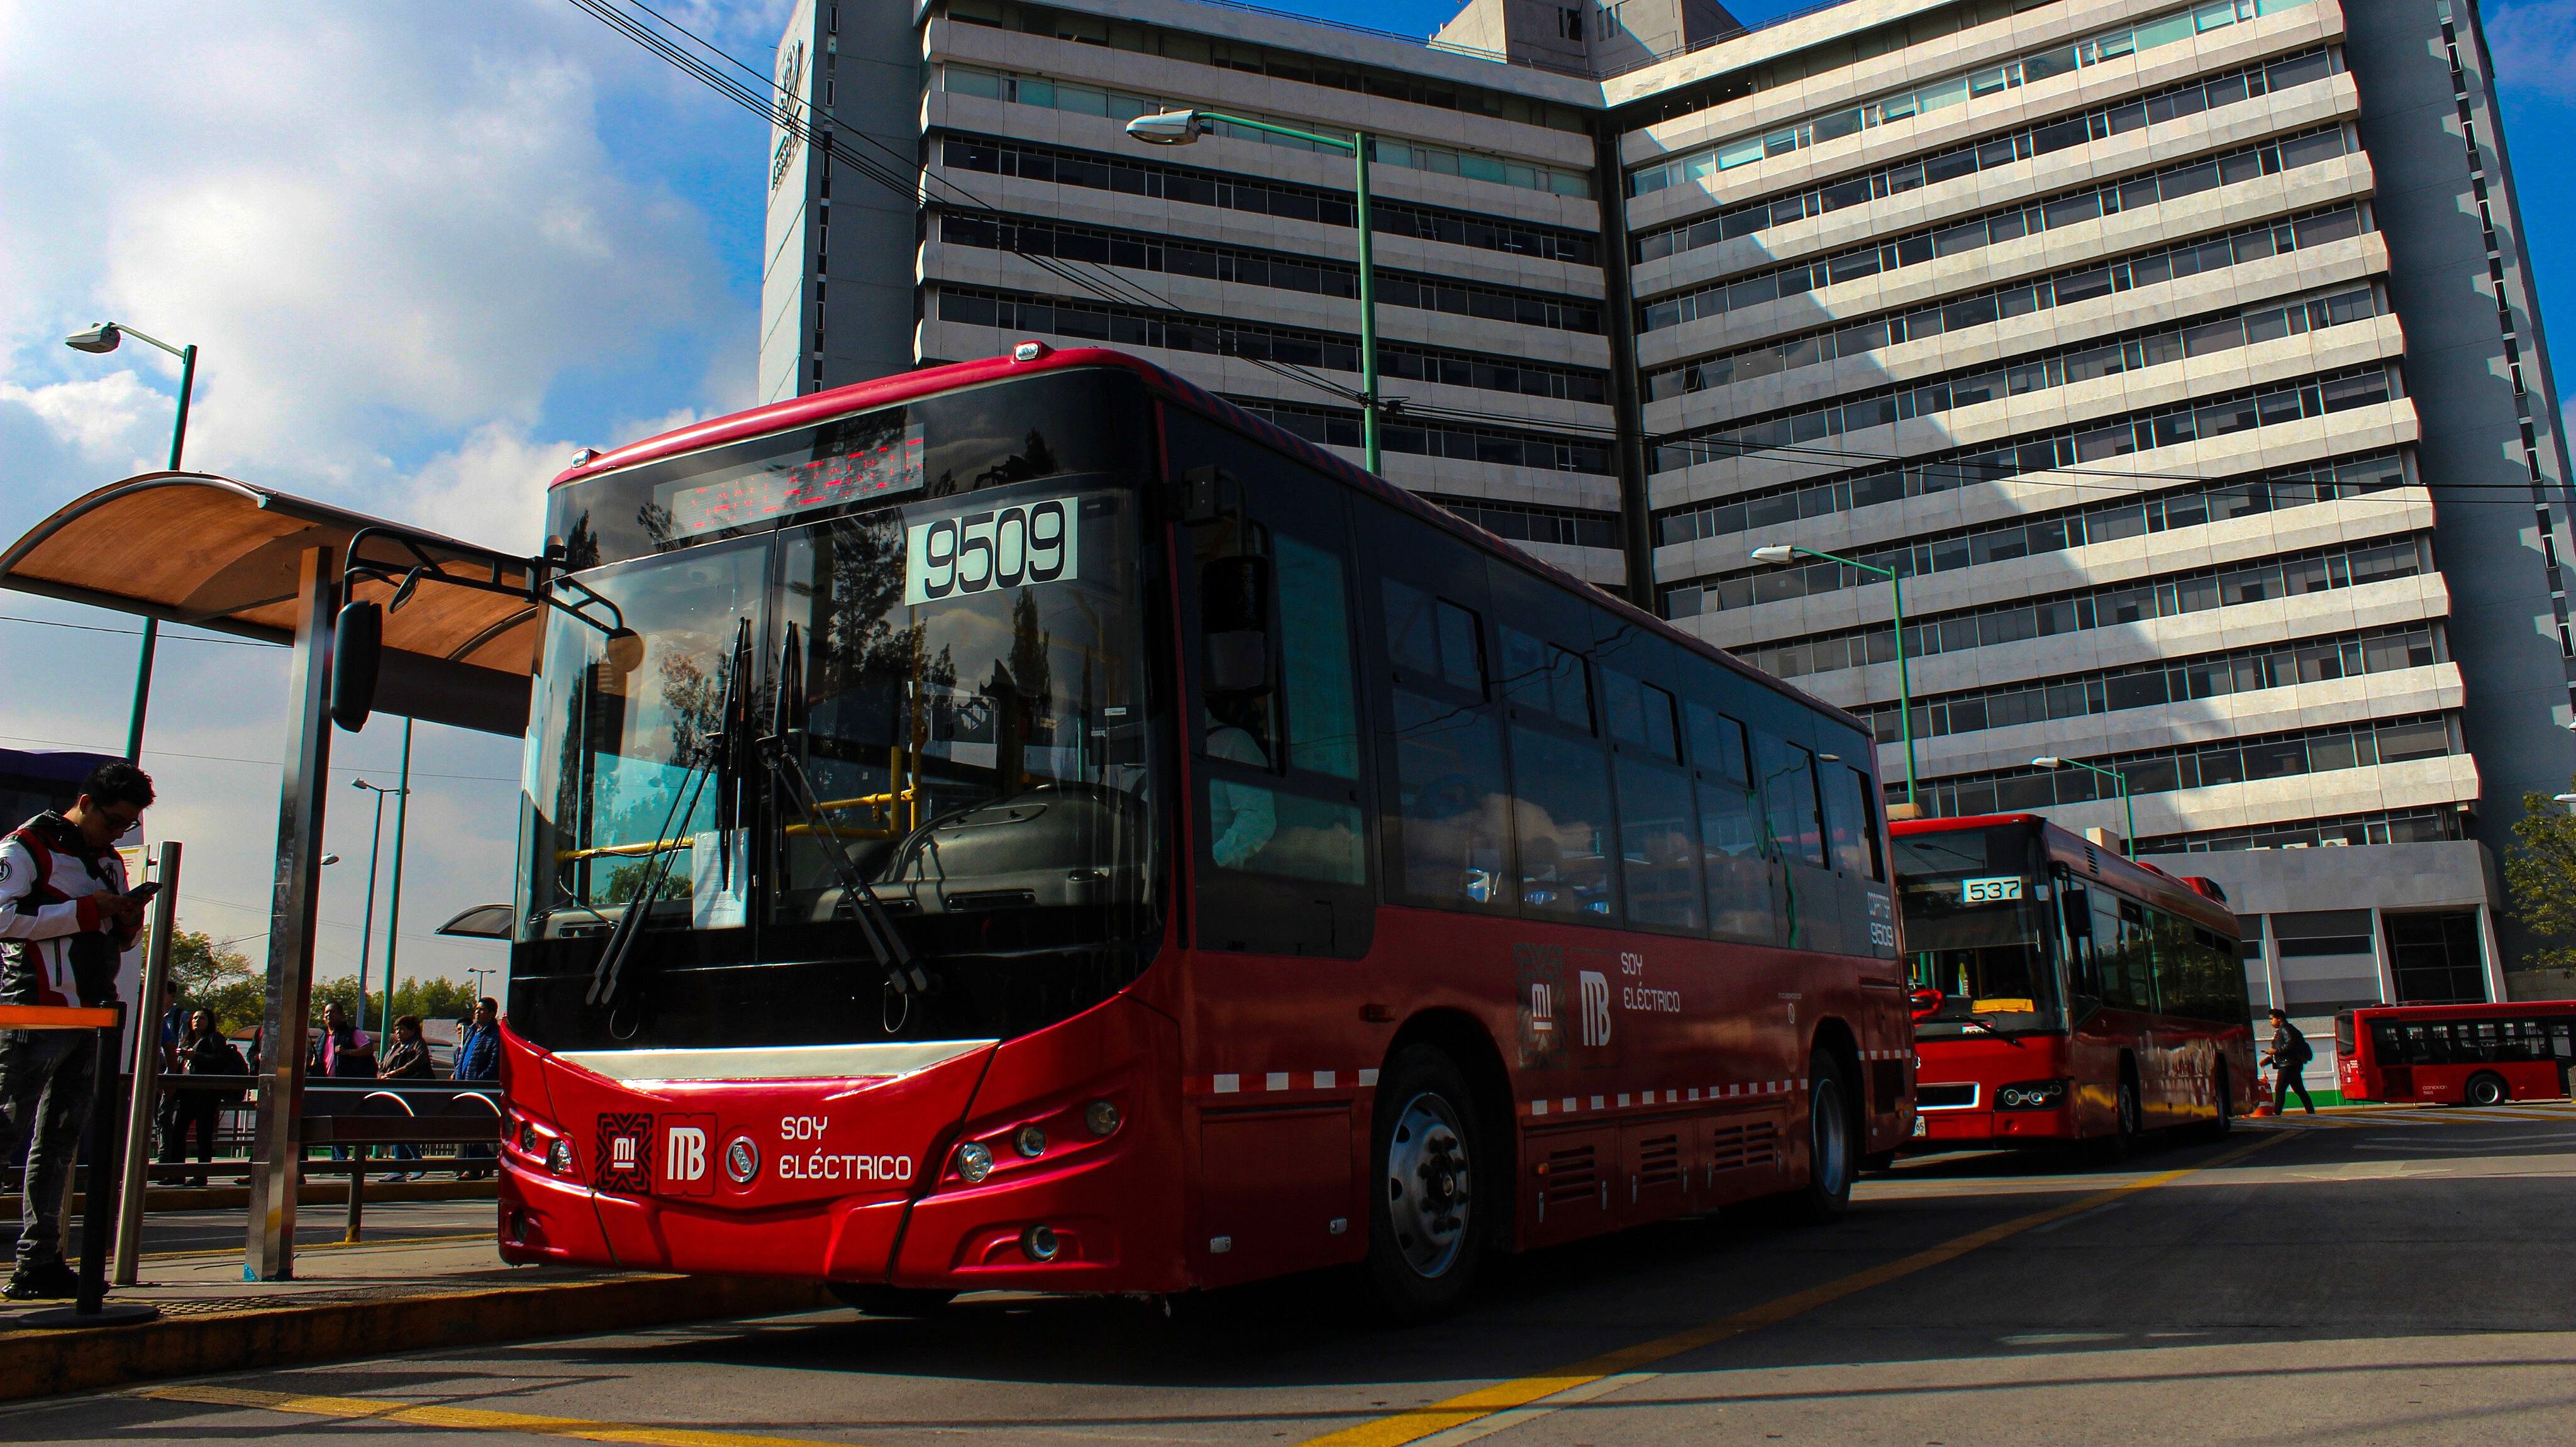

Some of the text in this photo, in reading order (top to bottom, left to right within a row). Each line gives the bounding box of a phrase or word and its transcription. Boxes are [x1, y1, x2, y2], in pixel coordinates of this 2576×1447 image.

[924, 501, 1065, 599] 9509
[1970, 880, 2019, 901] 537
[1870, 922, 1894, 947] 9509
[1621, 952, 1643, 975] SOY
[1580, 970, 1611, 1046] MB
[1624, 981, 1680, 1012] ELÉCTRICO
[780, 1116, 828, 1140] SOY
[667, 1127, 706, 1180] MB
[779, 1148, 912, 1180] ELÉCTRICO
